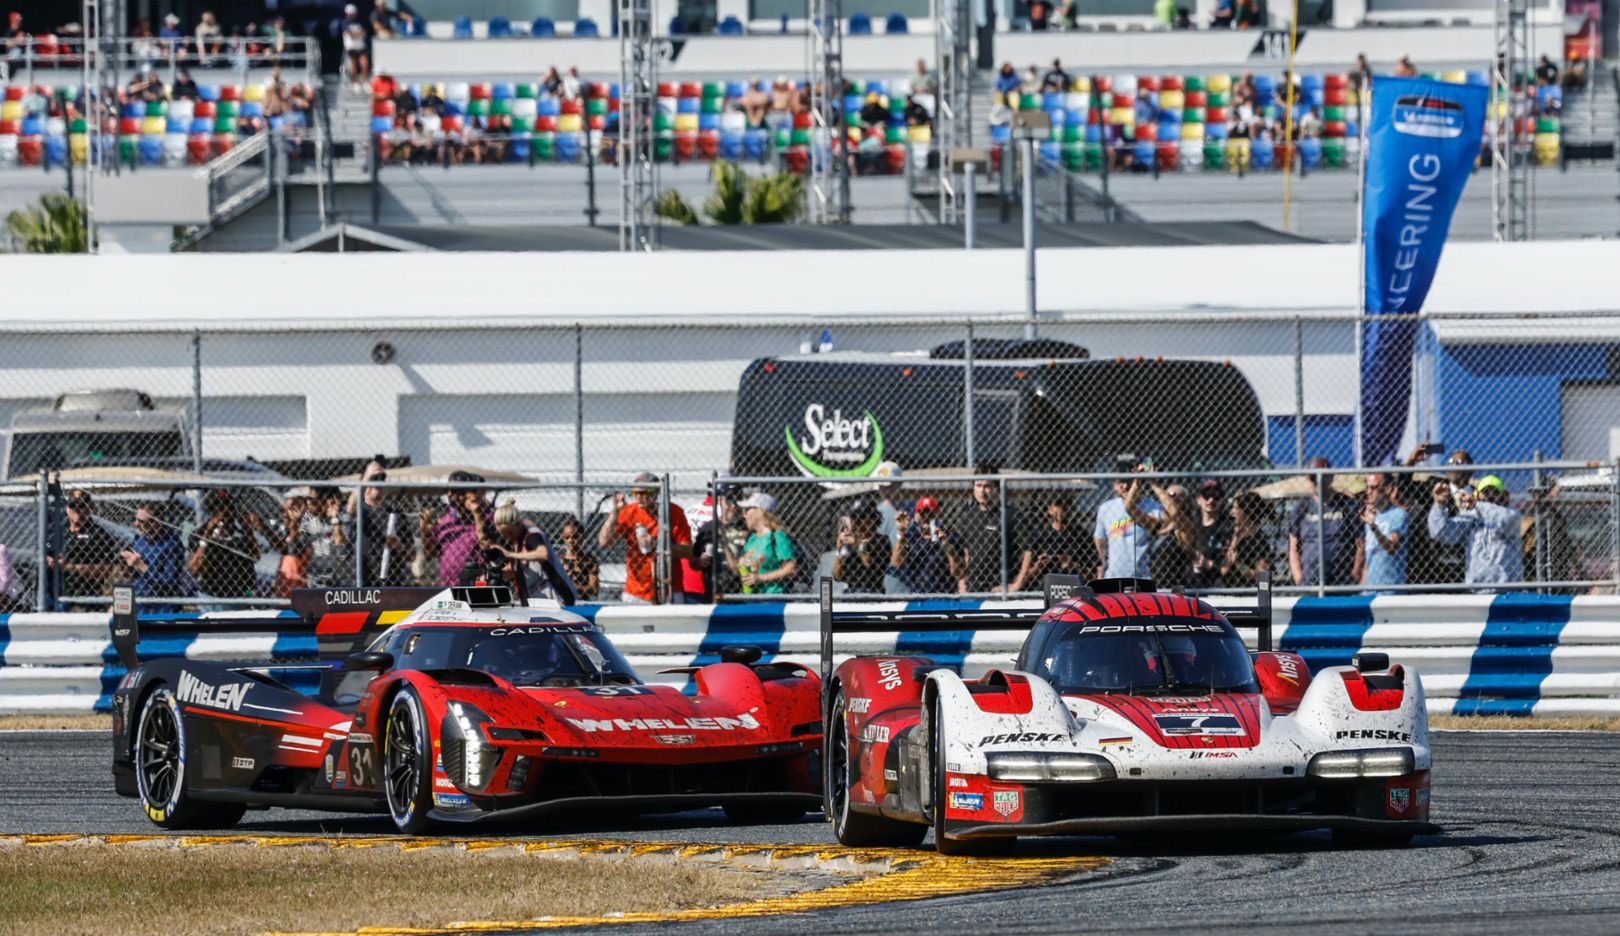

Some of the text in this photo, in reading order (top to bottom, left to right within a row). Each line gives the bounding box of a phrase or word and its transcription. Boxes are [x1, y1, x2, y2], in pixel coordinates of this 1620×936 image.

[801, 403, 871, 455] Select
[324, 589, 382, 605] CADILLAC
[490, 625, 593, 637] CADILLA
[1079, 624, 1226, 635] PORSCHE
[177, 669, 251, 711] WHELEN
[848, 698, 873, 713] PENSKE
[565, 713, 761, 732] WHELEN
[1180, 716, 1210, 727] 7
[978, 732, 1065, 748] PENSKE
[1336, 729, 1412, 743] PENSKE
[351, 746, 377, 786] 31
[994, 792, 1019, 802] TAG
